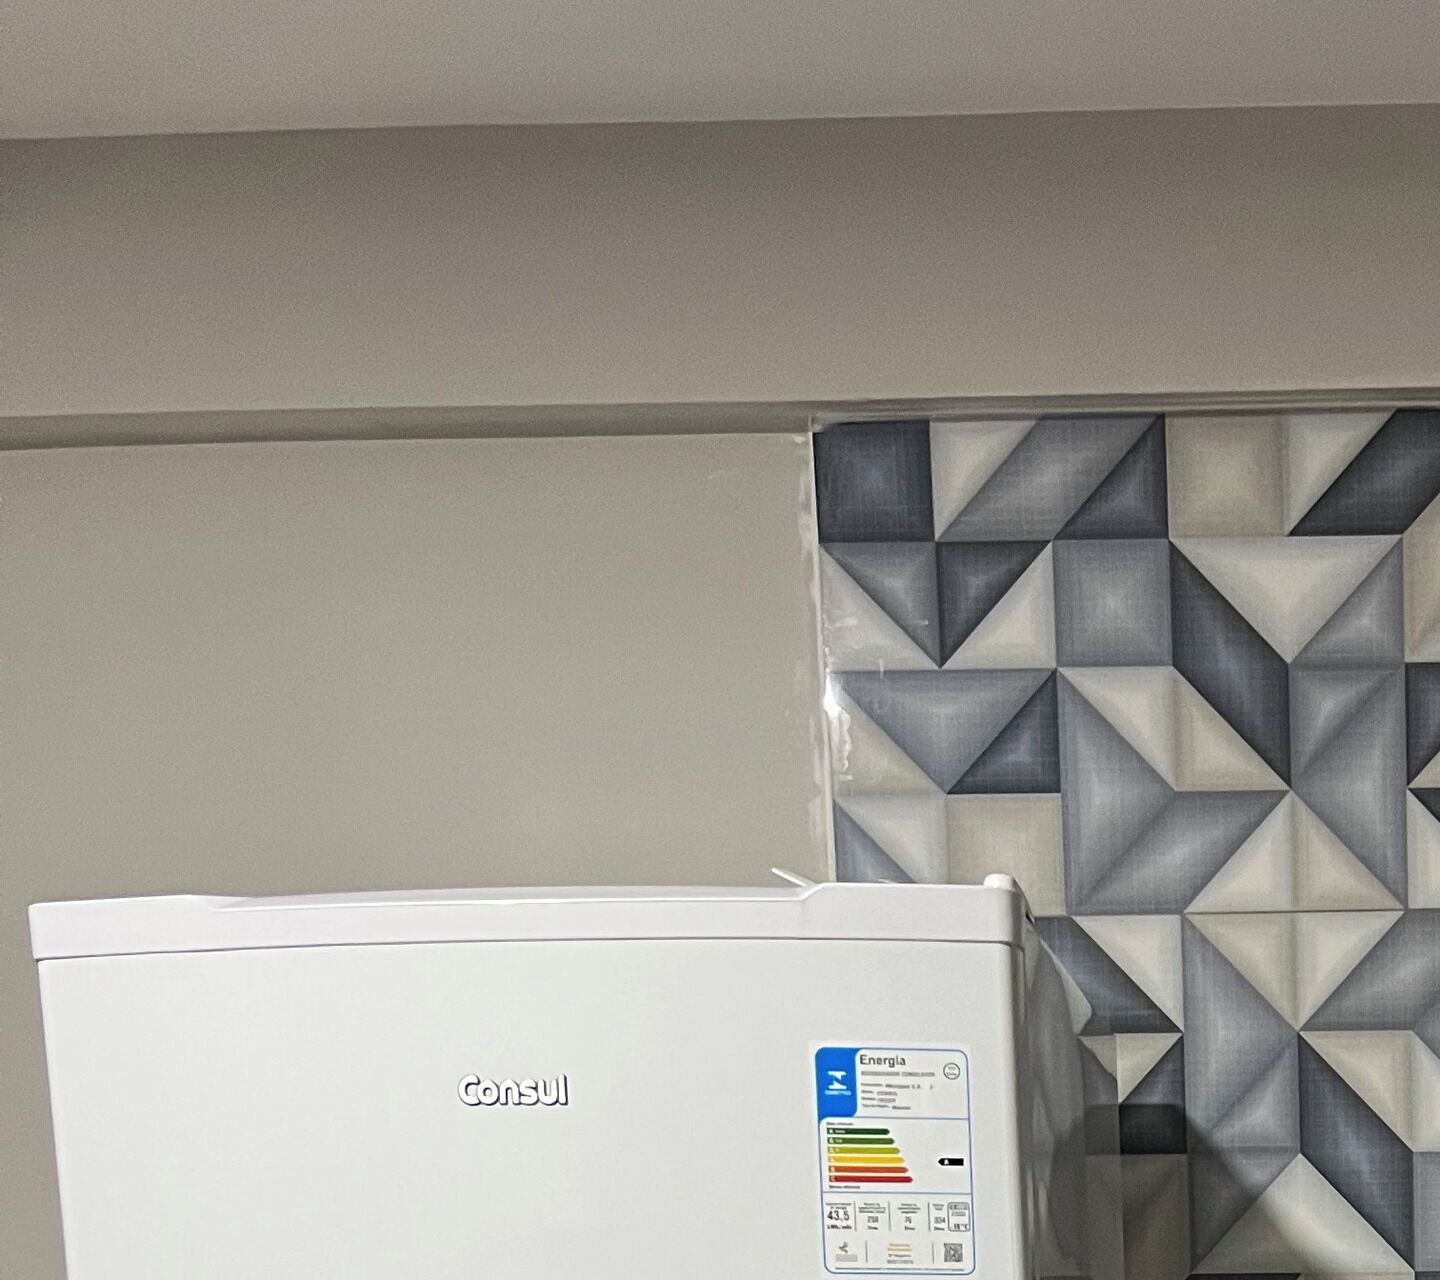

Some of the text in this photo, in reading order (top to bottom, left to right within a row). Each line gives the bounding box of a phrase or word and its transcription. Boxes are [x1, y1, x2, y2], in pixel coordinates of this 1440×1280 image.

[860, 1054, 906, 1068] Energia
[458, 1073, 568, 1106] Consul
[827, 1210, 850, 1222] 43,5
